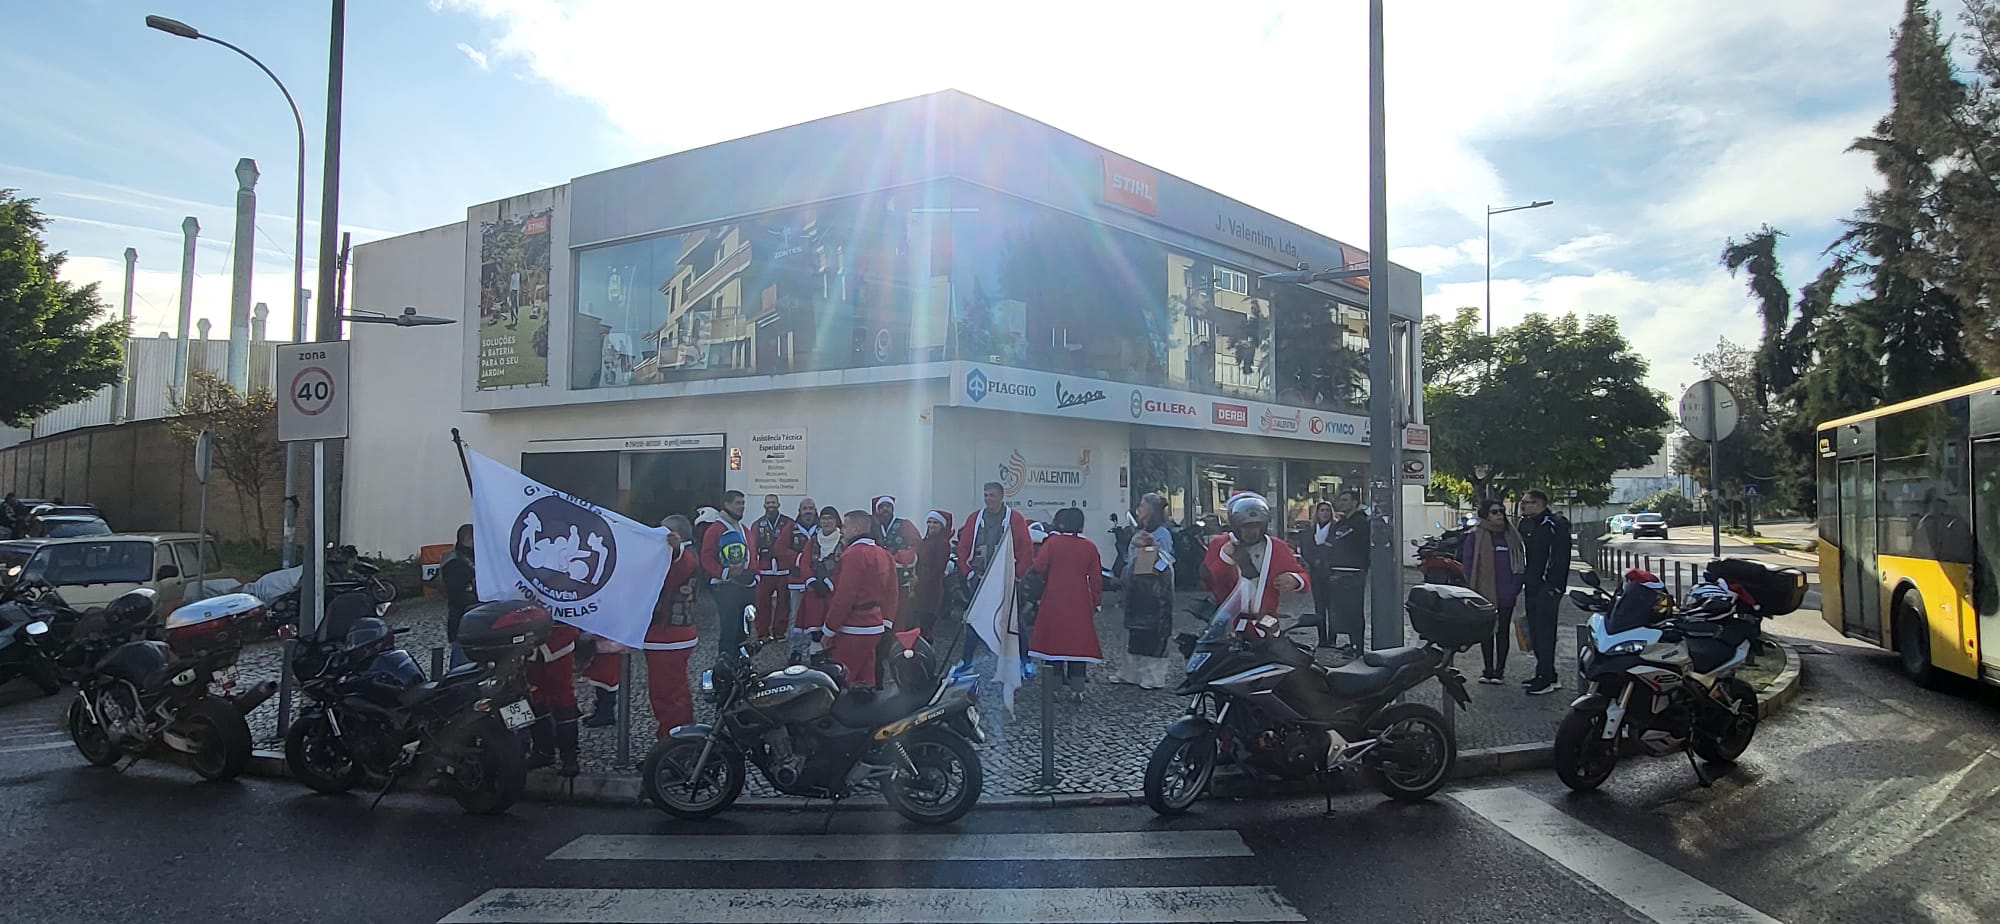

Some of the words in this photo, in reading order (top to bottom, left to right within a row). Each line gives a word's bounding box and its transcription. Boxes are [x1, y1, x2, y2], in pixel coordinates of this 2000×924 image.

[1112, 174, 1153, 201] STIHL
[1215, 214, 1226, 232] J.
[1228, 219, 1277, 252] Valentim,
[482, 334, 516, 347] SOLUÇÕES
[299, 351, 326, 360] zona
[488, 346, 514, 357] BATERIA
[481, 359, 498, 367] PARA
[499, 357, 505, 365] O
[506, 356, 519, 365] SEU
[481, 368, 505, 377] JARDIM
[297, 381, 328, 401] 40
[988, 380, 1036, 397] PIAGGIO
[1056, 379, 1107, 409] Vespa
[1144, 400, 1196, 416] GILERA
[1218, 408, 1246, 422] DERBI
[1325, 419, 1354, 435] KYMCO
[752, 432, 781, 442] Assistência
[782, 432, 803, 441] Técnica
[759, 443, 795, 453] Especializada
[1028, 470, 1080, 484] JVALENTIM
[515, 579, 599, 618] MONELAS
[756, 684, 795, 699] HONDA
[509, 703, 521, 715] 05
